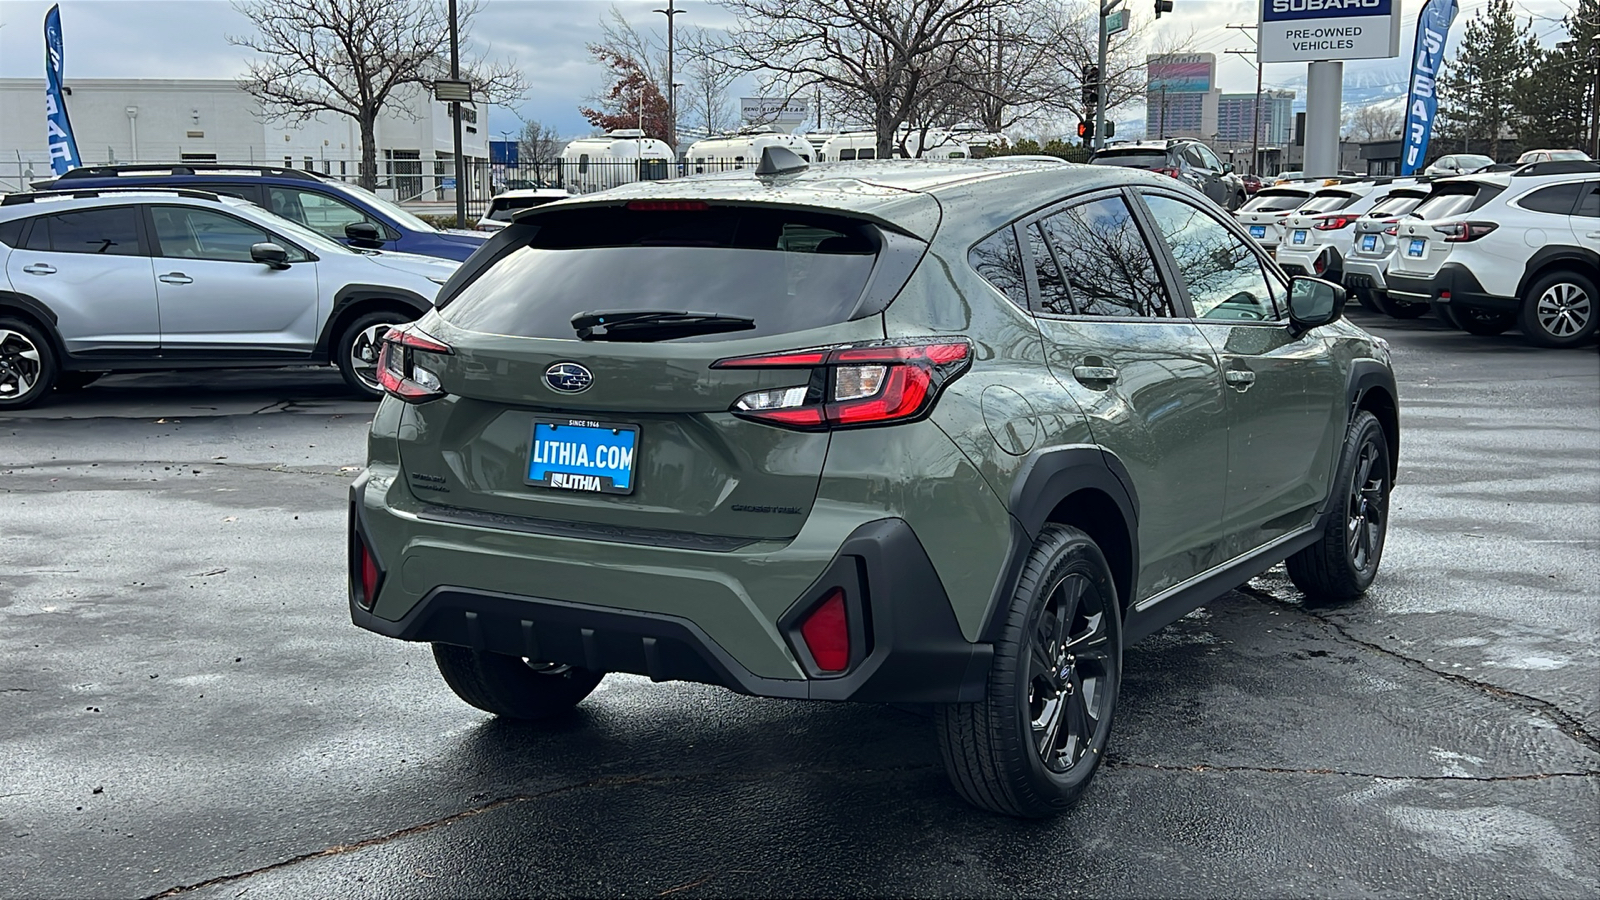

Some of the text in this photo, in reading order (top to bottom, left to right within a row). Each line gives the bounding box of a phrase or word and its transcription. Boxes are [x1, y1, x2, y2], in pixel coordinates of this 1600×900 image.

[1286, 27, 1362, 39] PRE-OWNED
[1292, 40, 1354, 51] VEHICLES
[569, 419, 585, 427] SINCE
[533, 440, 634, 471] LITHIA.COM
[562, 473, 601, 492] LITHIA
